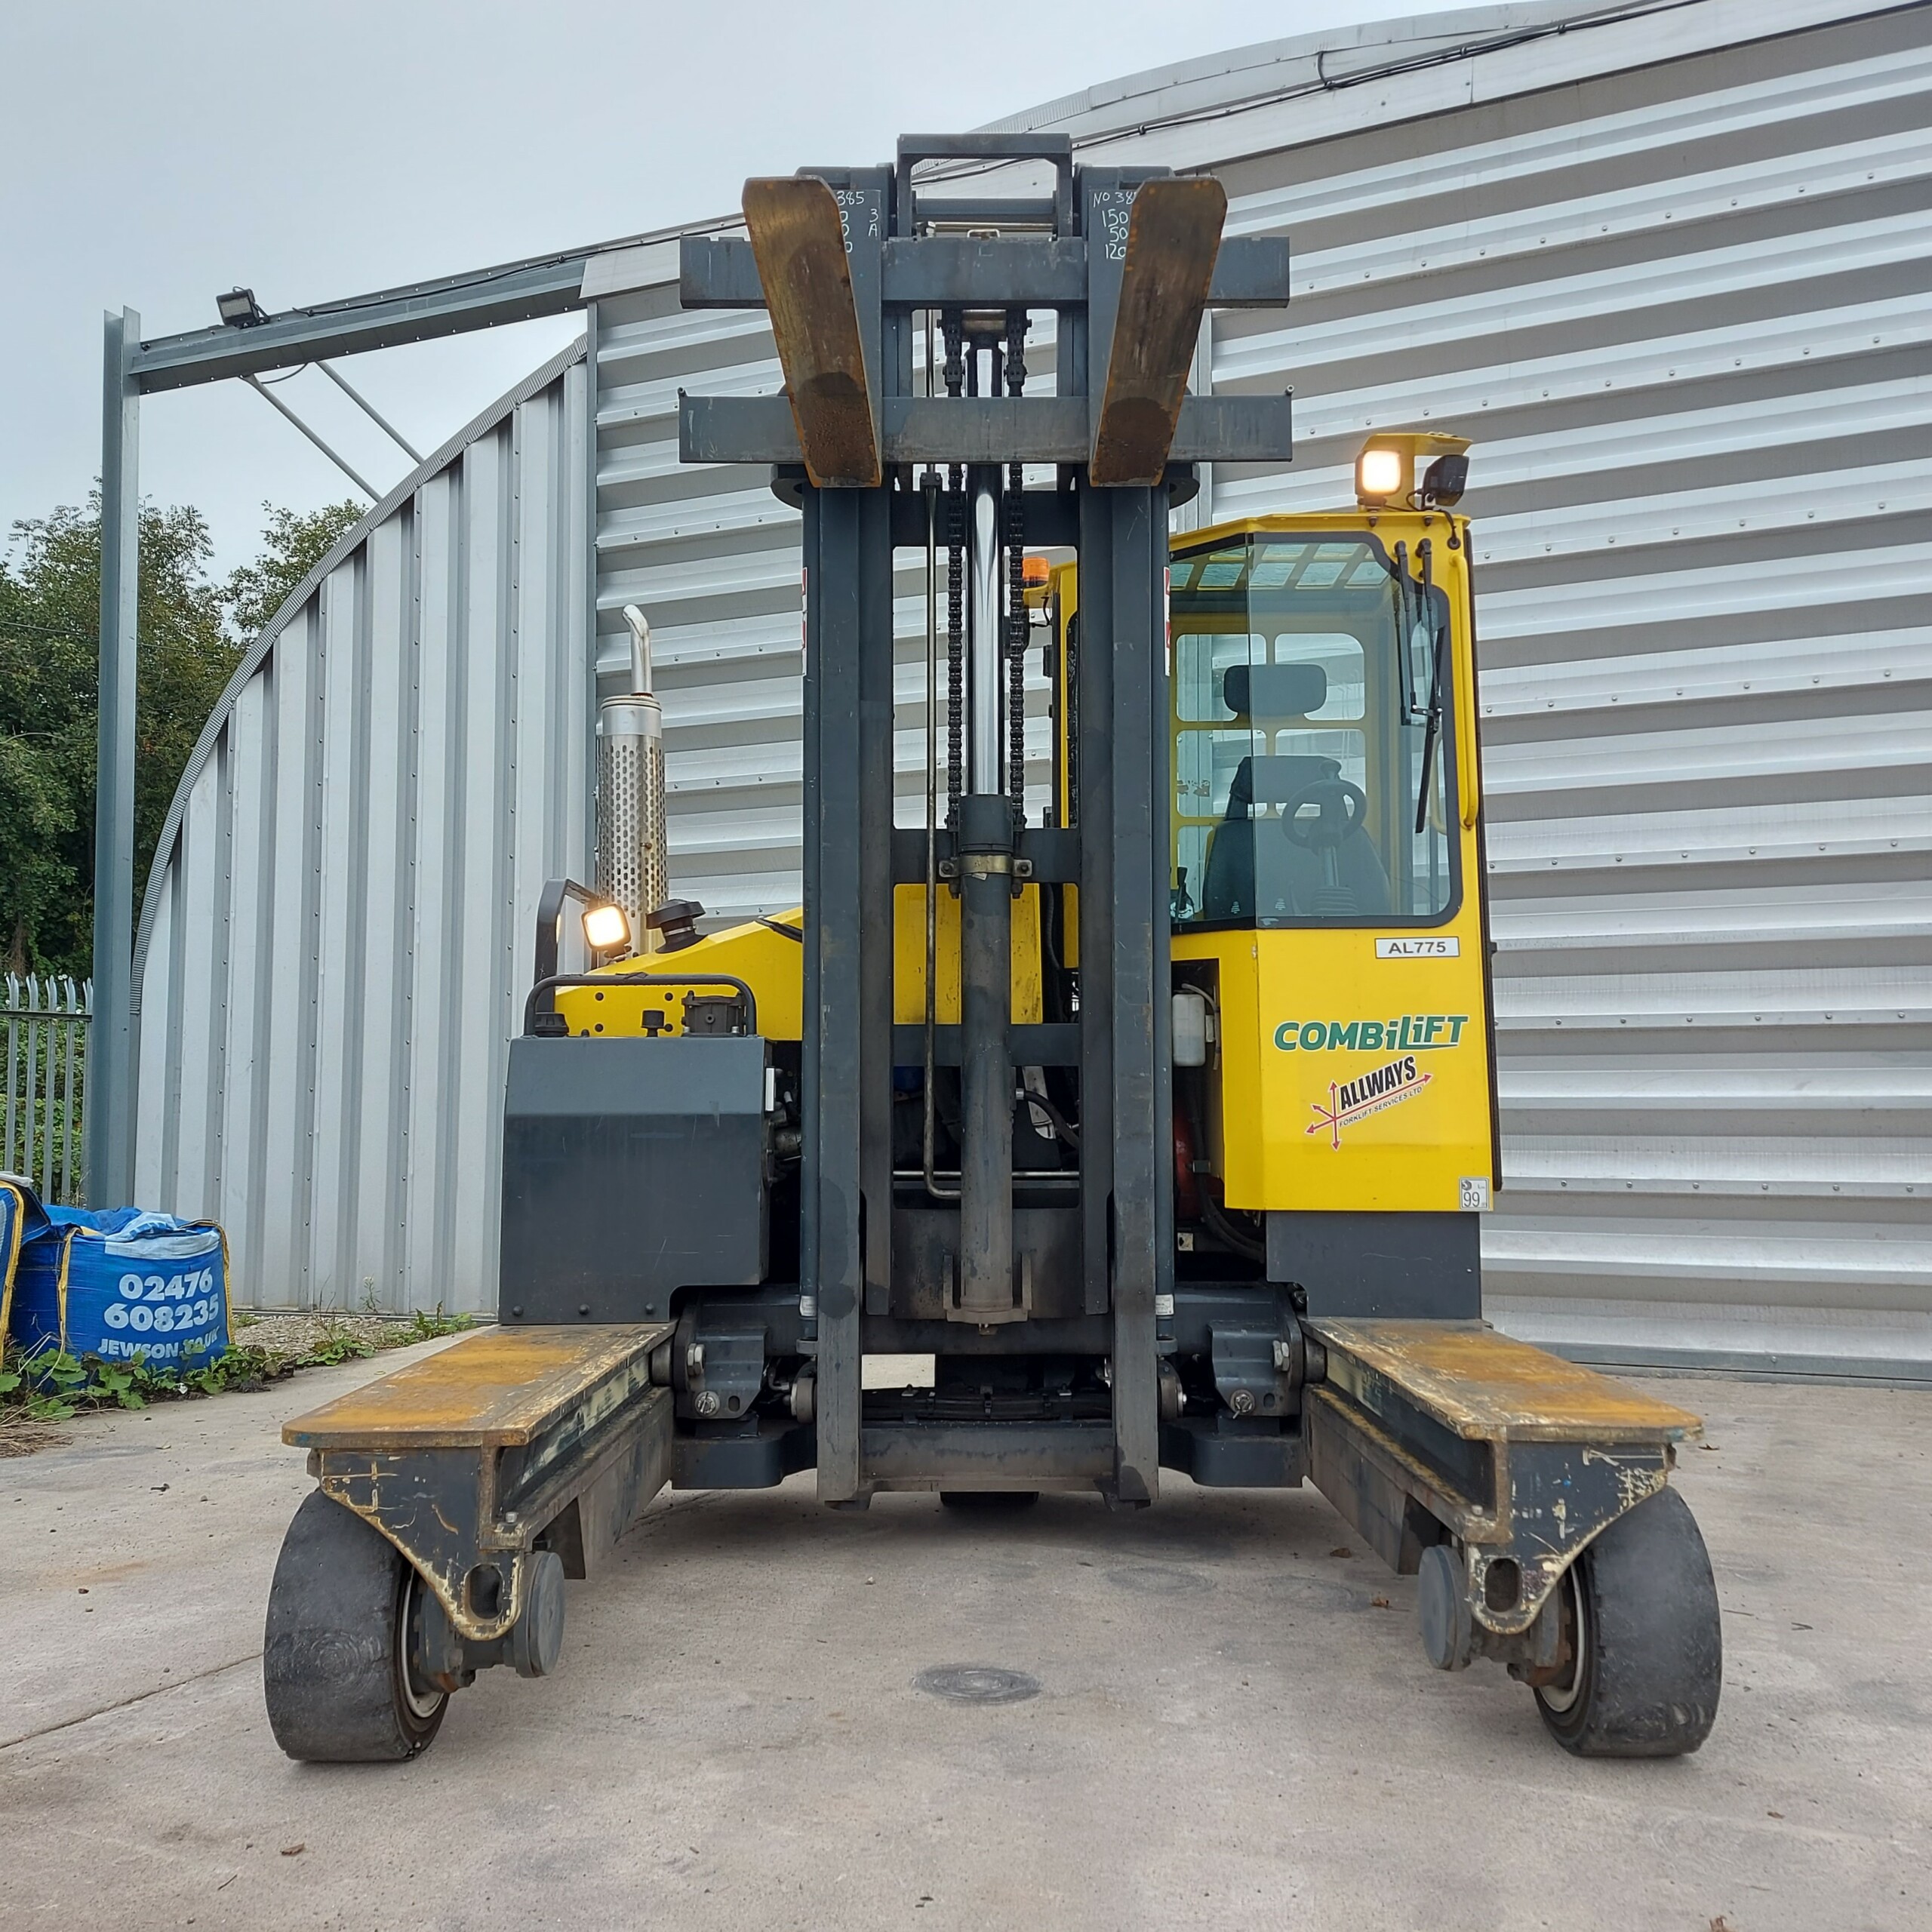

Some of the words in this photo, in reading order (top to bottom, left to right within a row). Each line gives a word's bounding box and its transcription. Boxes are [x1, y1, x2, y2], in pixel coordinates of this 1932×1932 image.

[836, 190, 865, 206] 385
[1114, 190, 1137, 205] 38
[869, 208, 879, 223] 3
[1102, 208, 1129, 228] 150
[868, 223, 878, 237] A
[1109, 226, 1129, 242] 50
[1105, 243, 1127, 260] 120
[1388, 941, 1447, 955] AL775
[1339, 1055, 1417, 1112] ALLWAYS
[1339, 1108, 1373, 1128] FORKLIFT
[1374, 1092, 1408, 1112] SERVICES
[1409, 1086, 1423, 1097] LTD
[1463, 1191, 1480, 1208] 99
[118, 1266, 214, 1302] 02476
[103, 1292, 220, 1333] 608235
